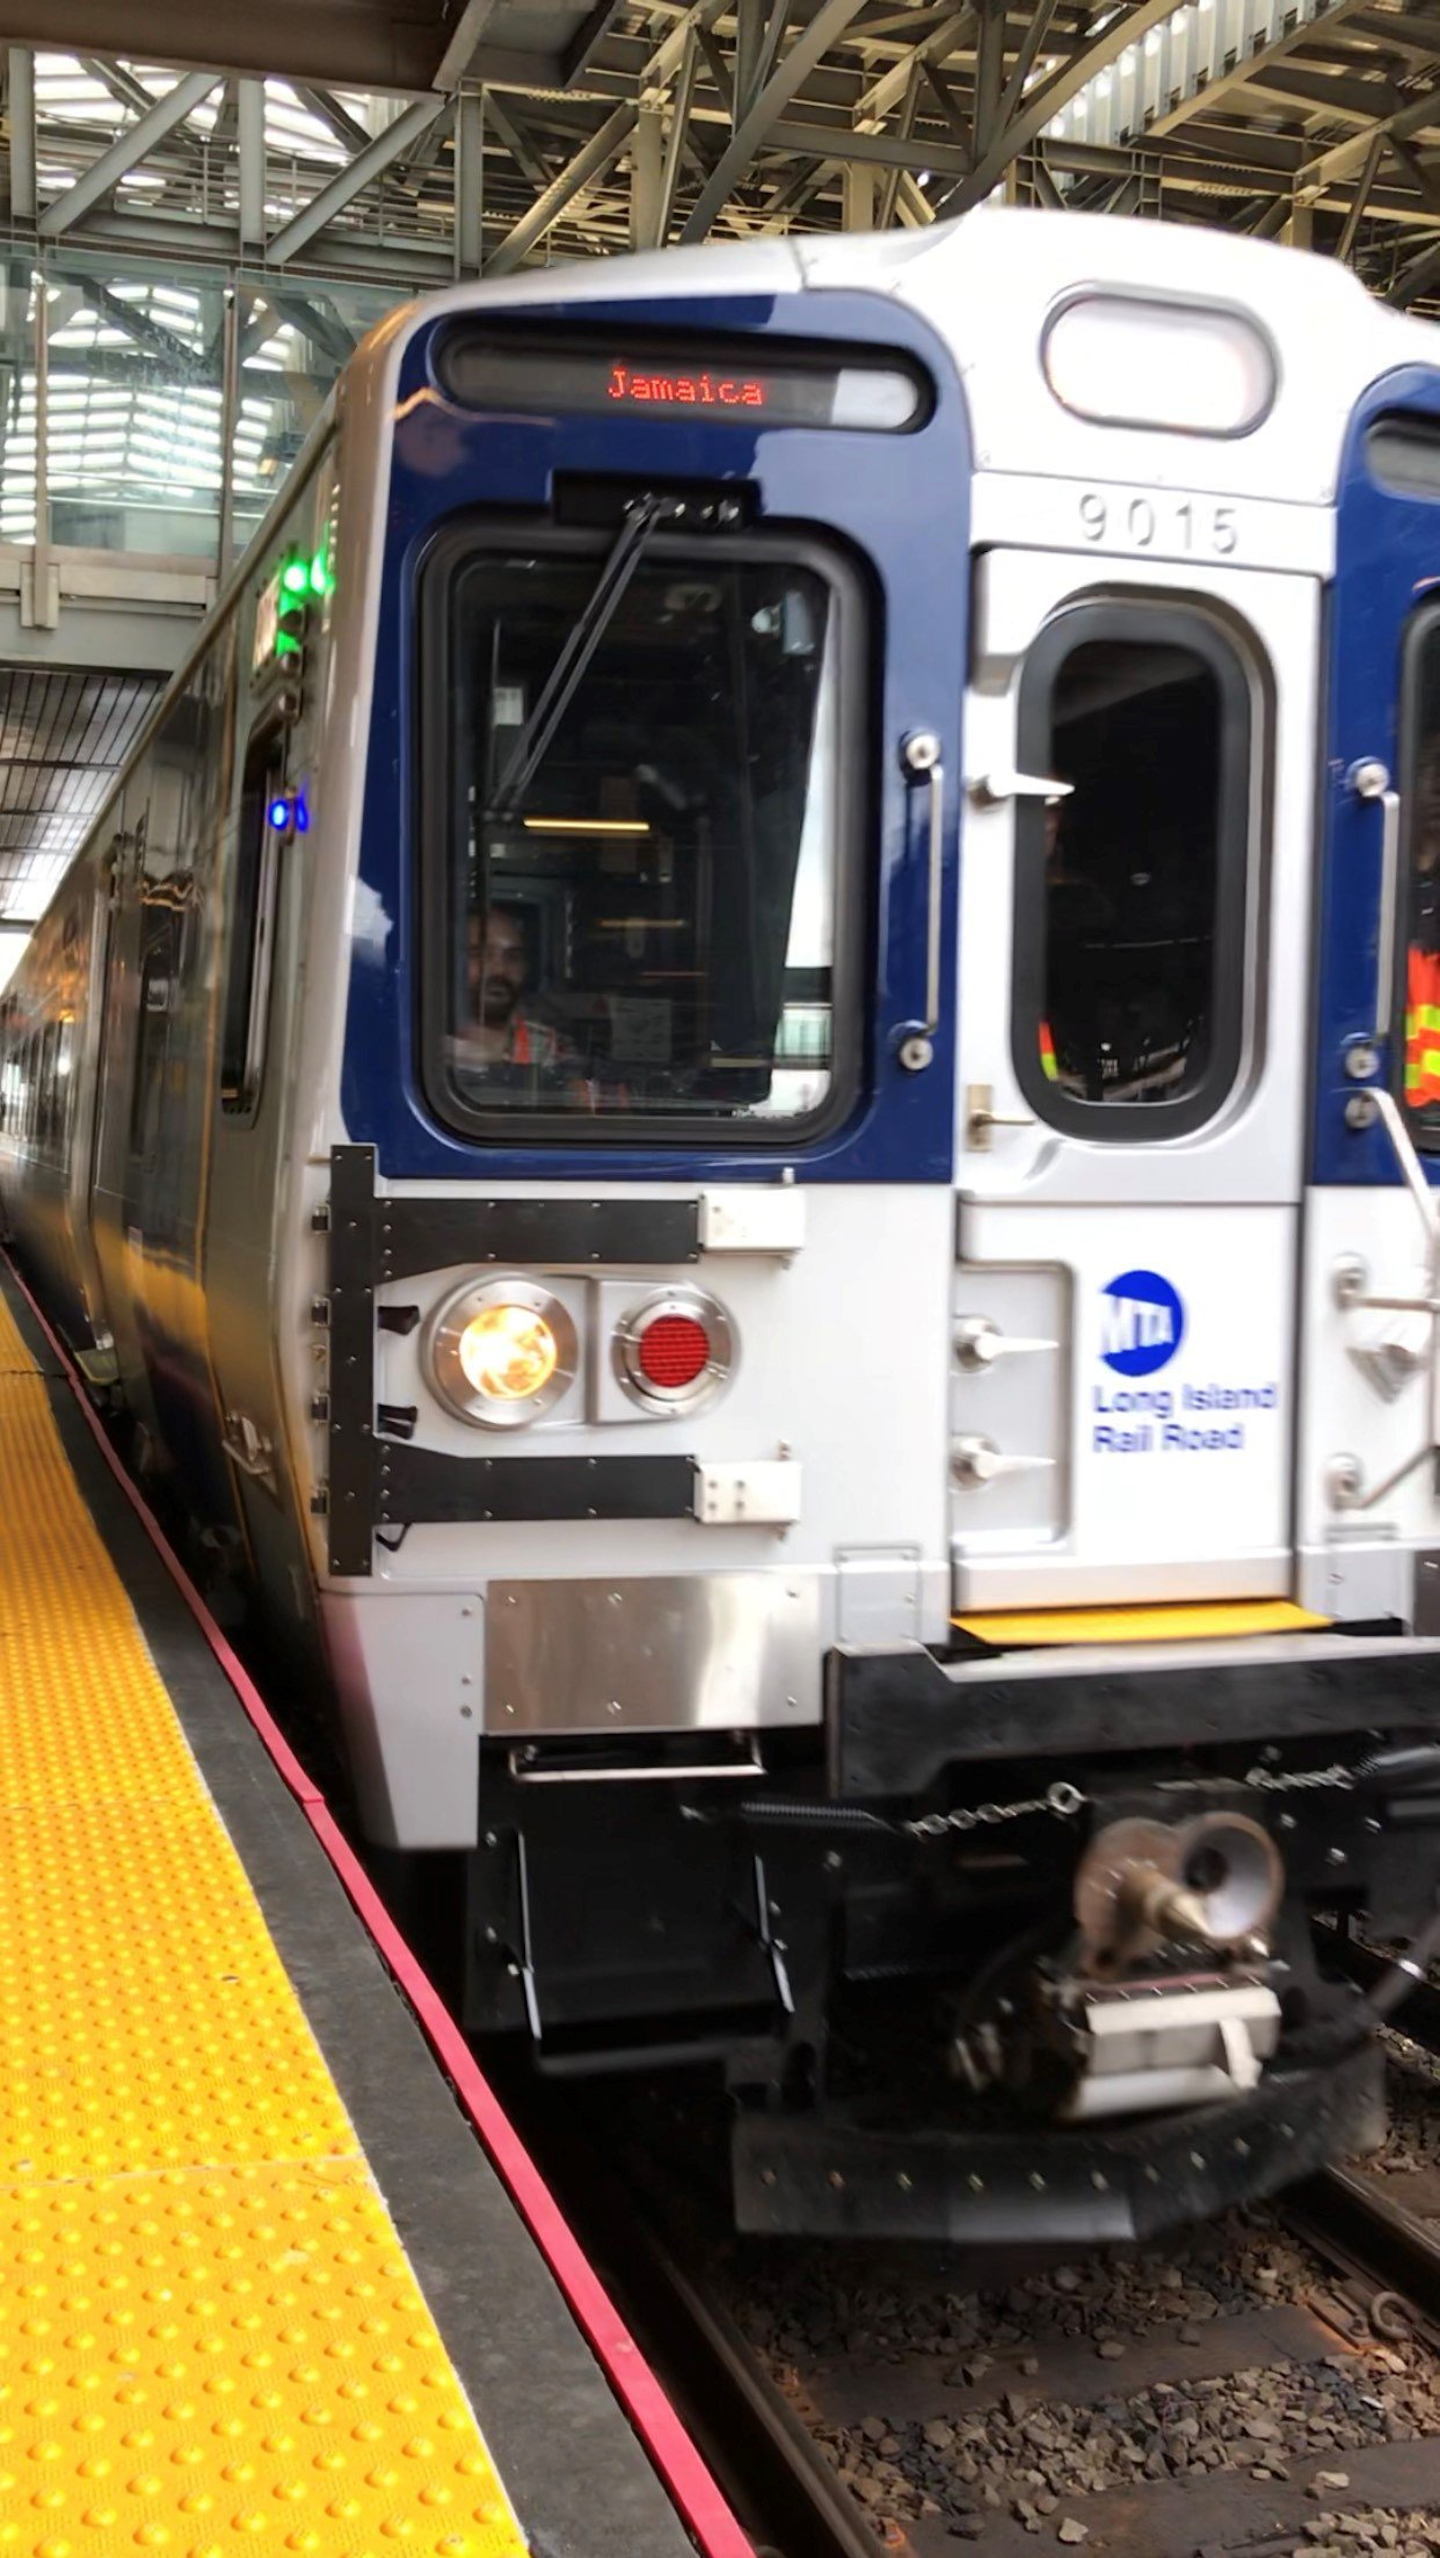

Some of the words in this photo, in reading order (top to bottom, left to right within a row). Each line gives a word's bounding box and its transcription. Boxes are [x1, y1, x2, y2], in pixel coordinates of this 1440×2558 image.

[607, 367, 762, 405] Jamaica
[1078, 493, 1238, 555] 9015
[1093, 1386, 1173, 1419] Long
[1182, 1383, 1277, 1410] Island
[1094, 1424, 1153, 1452] Rail
[1161, 1422, 1244, 1450] Road
